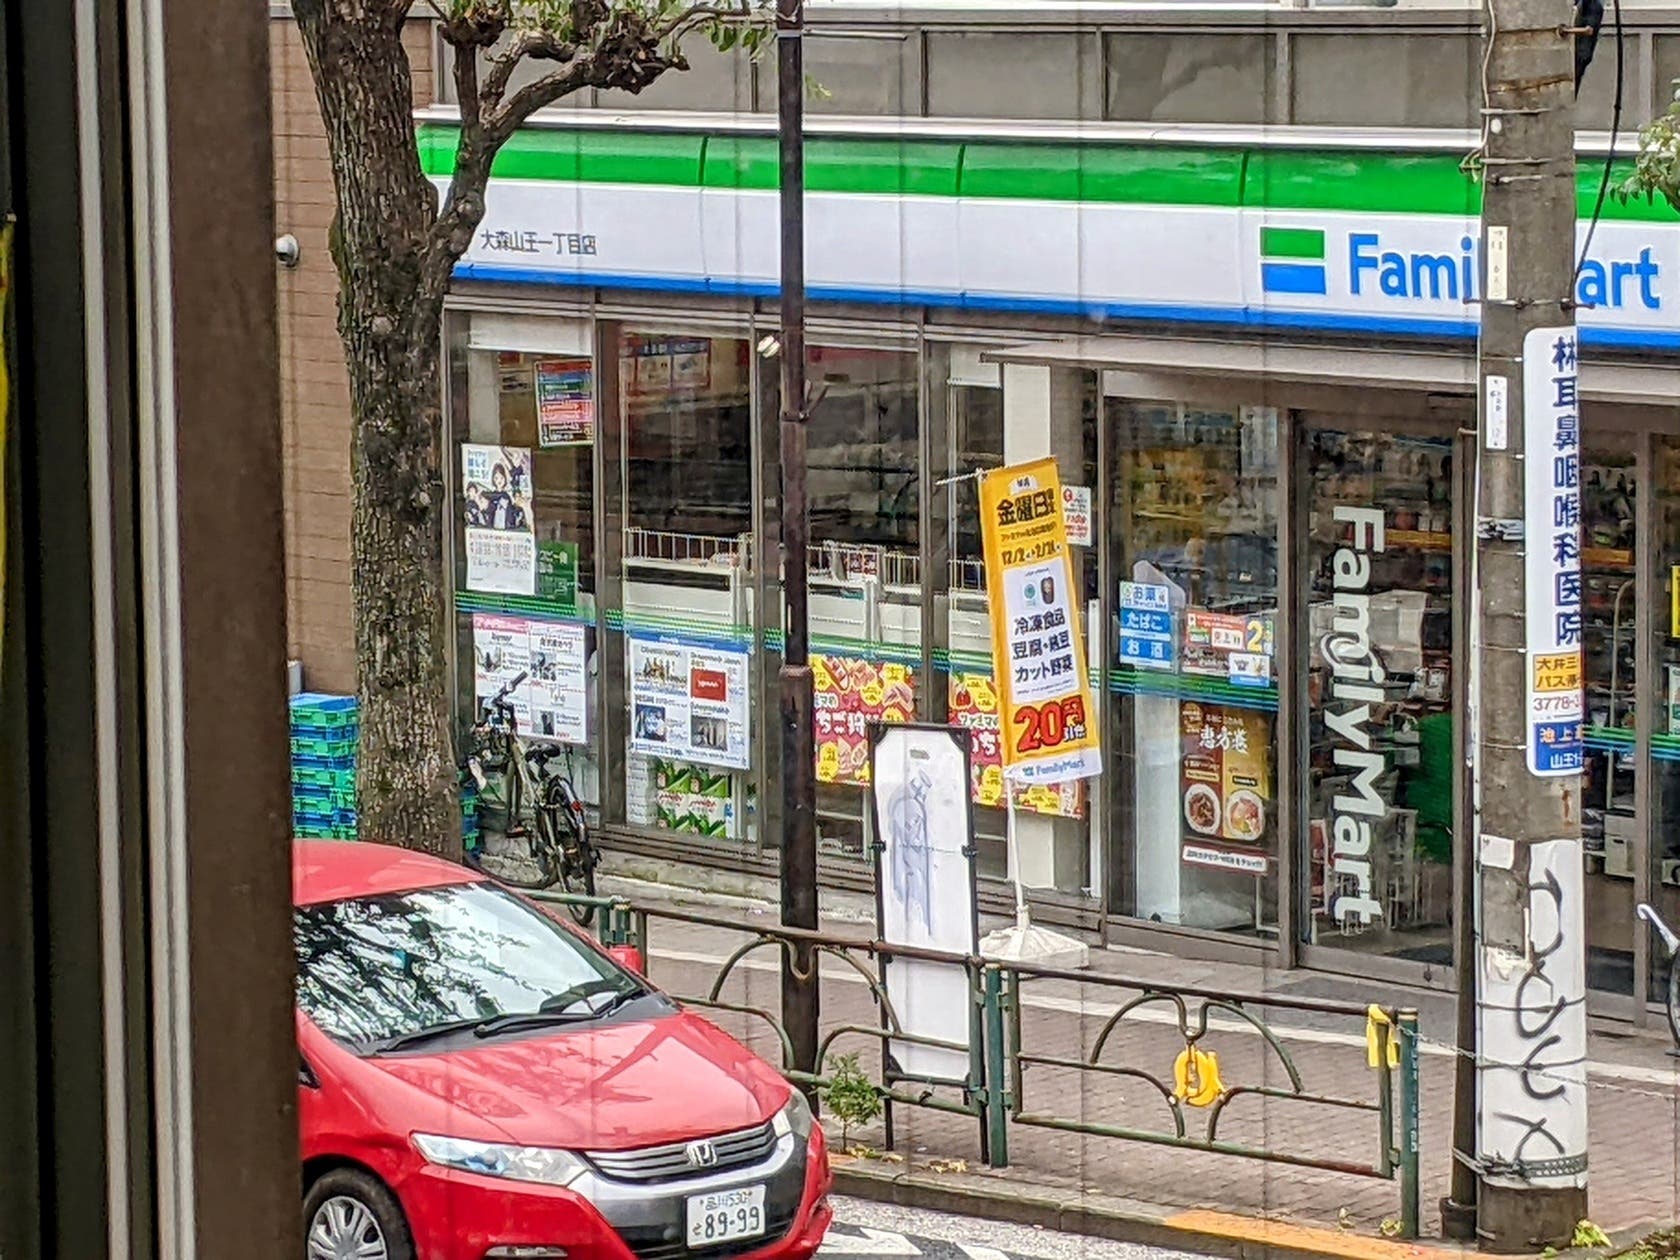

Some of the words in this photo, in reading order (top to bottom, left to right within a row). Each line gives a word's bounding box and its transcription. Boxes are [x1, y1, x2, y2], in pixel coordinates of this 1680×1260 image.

[481, 229, 597, 256] 大森山王一丁目店
[1014, 607, 1066, 636] 冷凍食品
[1126, 610, 1164, 632] たばこ
[1014, 653, 1074, 683] カット野菜
[1325, 505, 1386, 926] FamilyMart
[705, 1206, 760, 1239] 89-99
